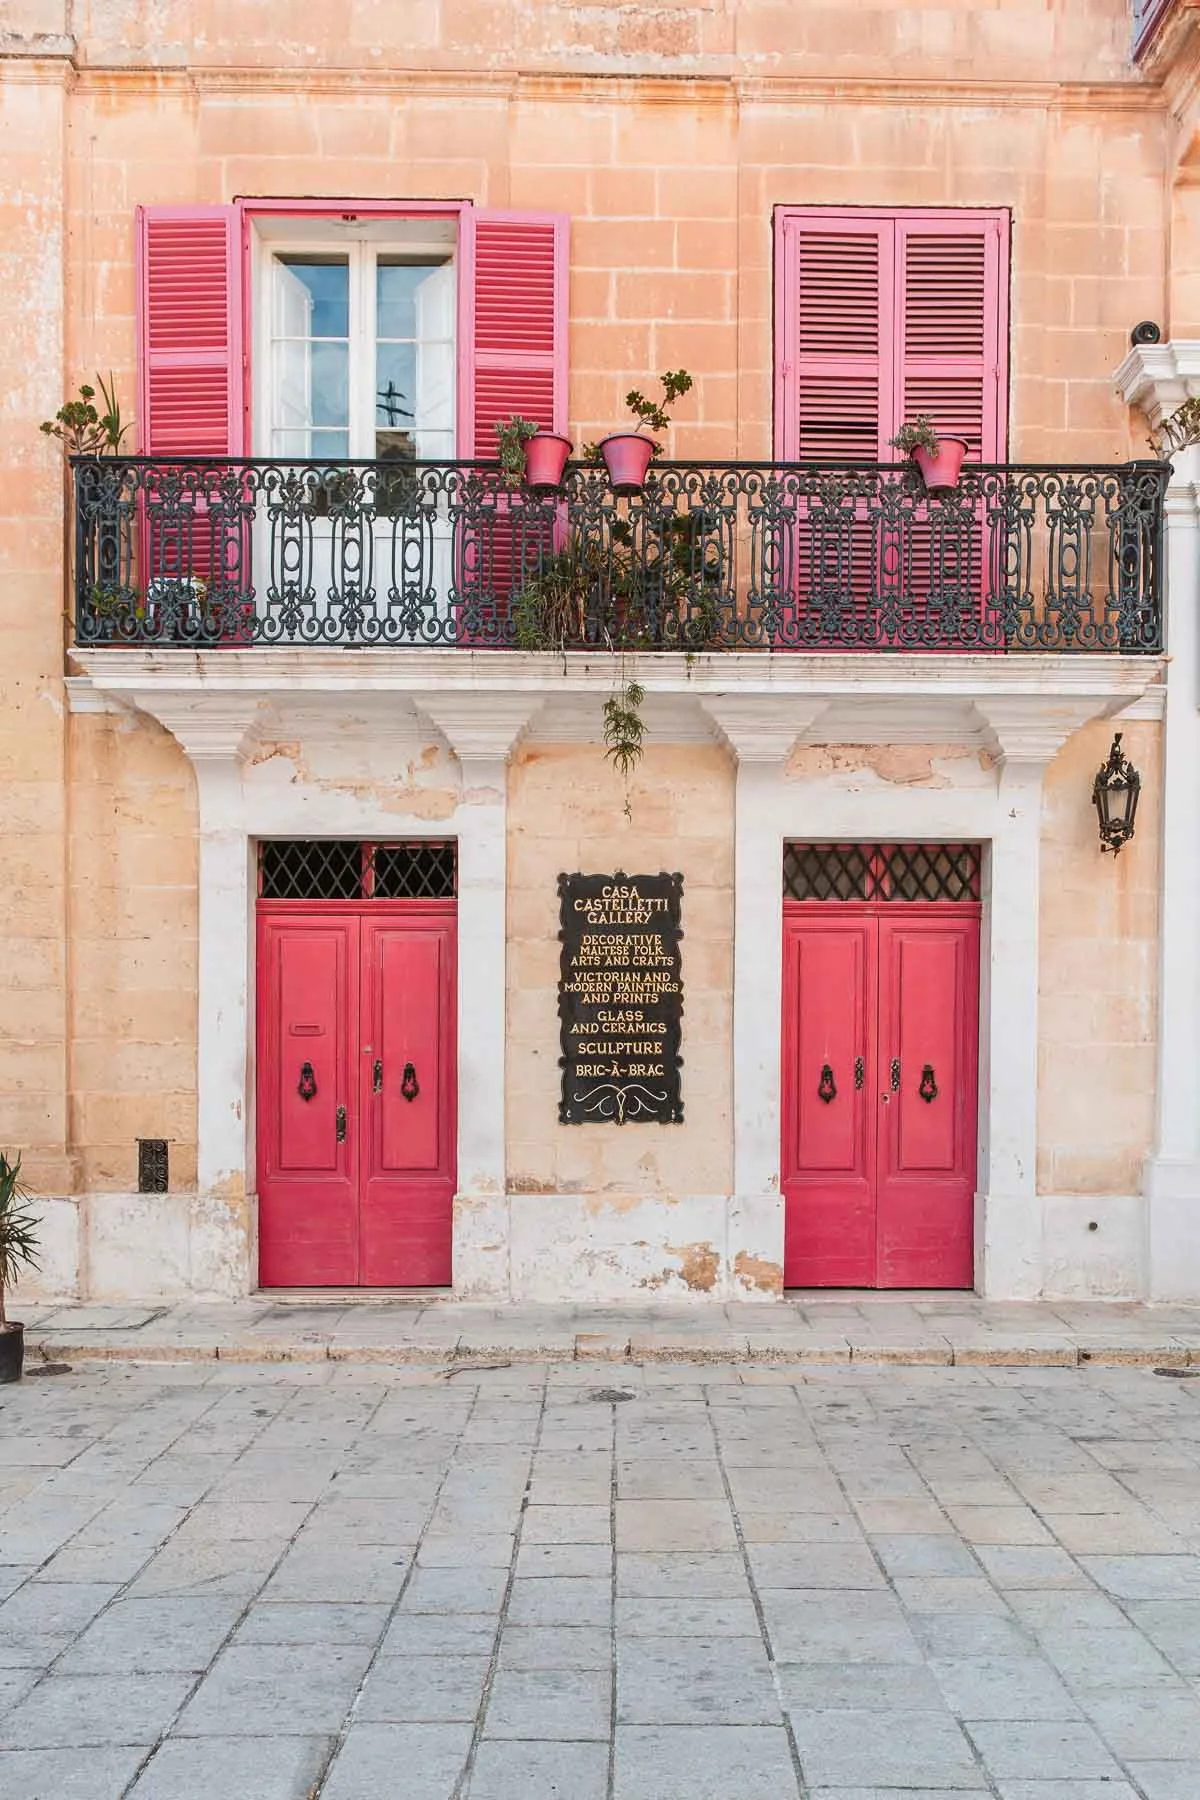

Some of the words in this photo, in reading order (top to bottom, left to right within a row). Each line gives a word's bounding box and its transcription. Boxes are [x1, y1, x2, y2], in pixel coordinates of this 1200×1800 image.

[602, 886, 639, 898] CASA
[574, 899, 669, 912] CASTELLETTI
[587, 911, 653, 924] GALLERY
[583, 934, 662, 945] DECORATIVE
[580, 946, 629, 956] MALTESE
[634, 946, 664, 956] FOLK
[570, 957, 600, 966] ARTS
[605, 957, 629, 966] AND
[632, 957, 674, 966] CRAFTS
[574, 972, 641, 982] VICTORIAN
[644, 972, 671, 982] AND
[564, 982, 612, 992] MODERN
[617, 982, 679, 992] PAINTINGS
[583, 993, 610, 1004] AND
[613, 993, 659, 1004] PRINTS
[597, 1010, 644, 1021] GLASS
[570, 1023, 599, 1033] AND
[602, 1023, 667, 1033] CERAMICS
[578, 1042, 663, 1055] SCULPTURE
